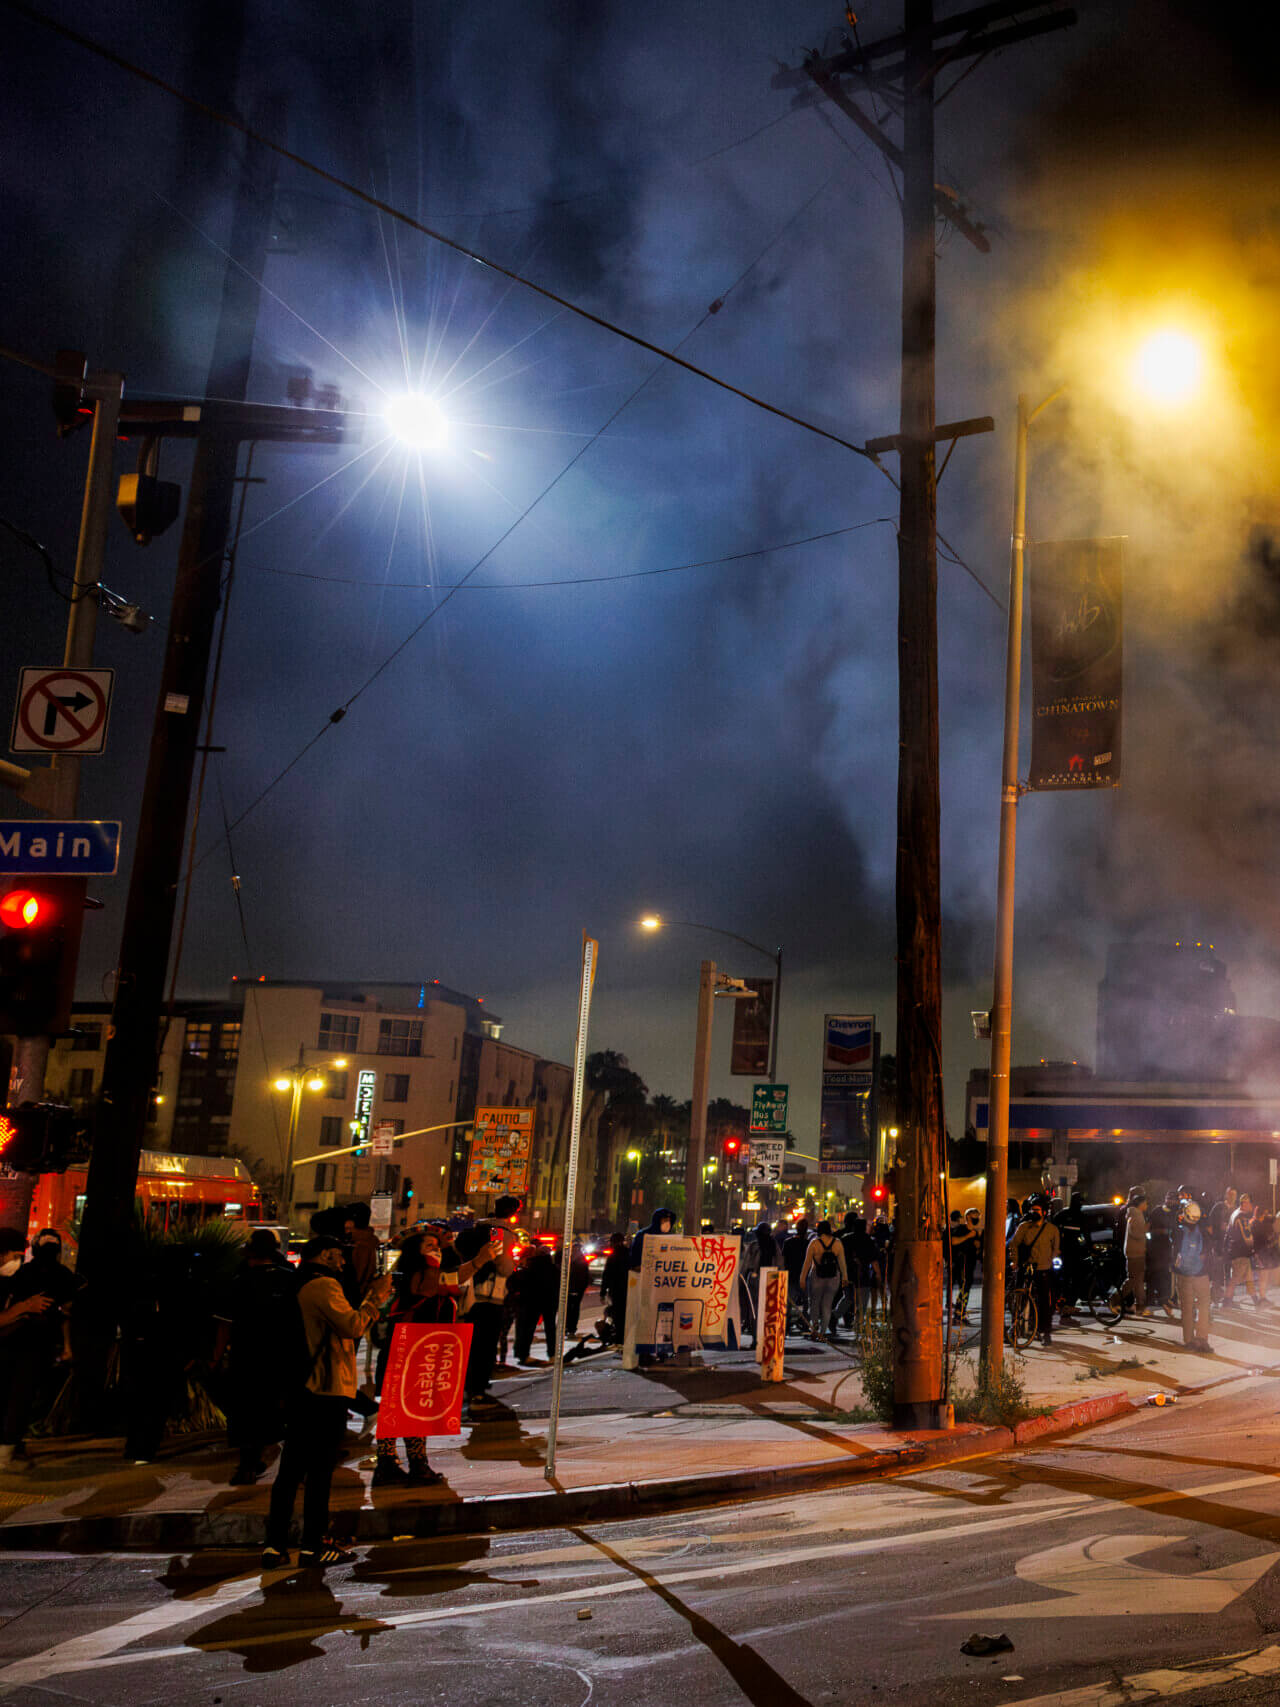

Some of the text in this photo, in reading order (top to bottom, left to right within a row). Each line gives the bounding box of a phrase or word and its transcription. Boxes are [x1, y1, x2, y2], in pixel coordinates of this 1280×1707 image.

[0, 832, 91, 857] Main
[482, 1113, 526, 1124] CAUTIO
[752, 1164, 781, 1181] 35
[655, 1261, 717, 1275] FUEL UP.
[654, 1276, 713, 1289] SAVE UP.
[418, 1343, 439, 1408] PUPPETS
[436, 1343, 455, 1391] MAGA
